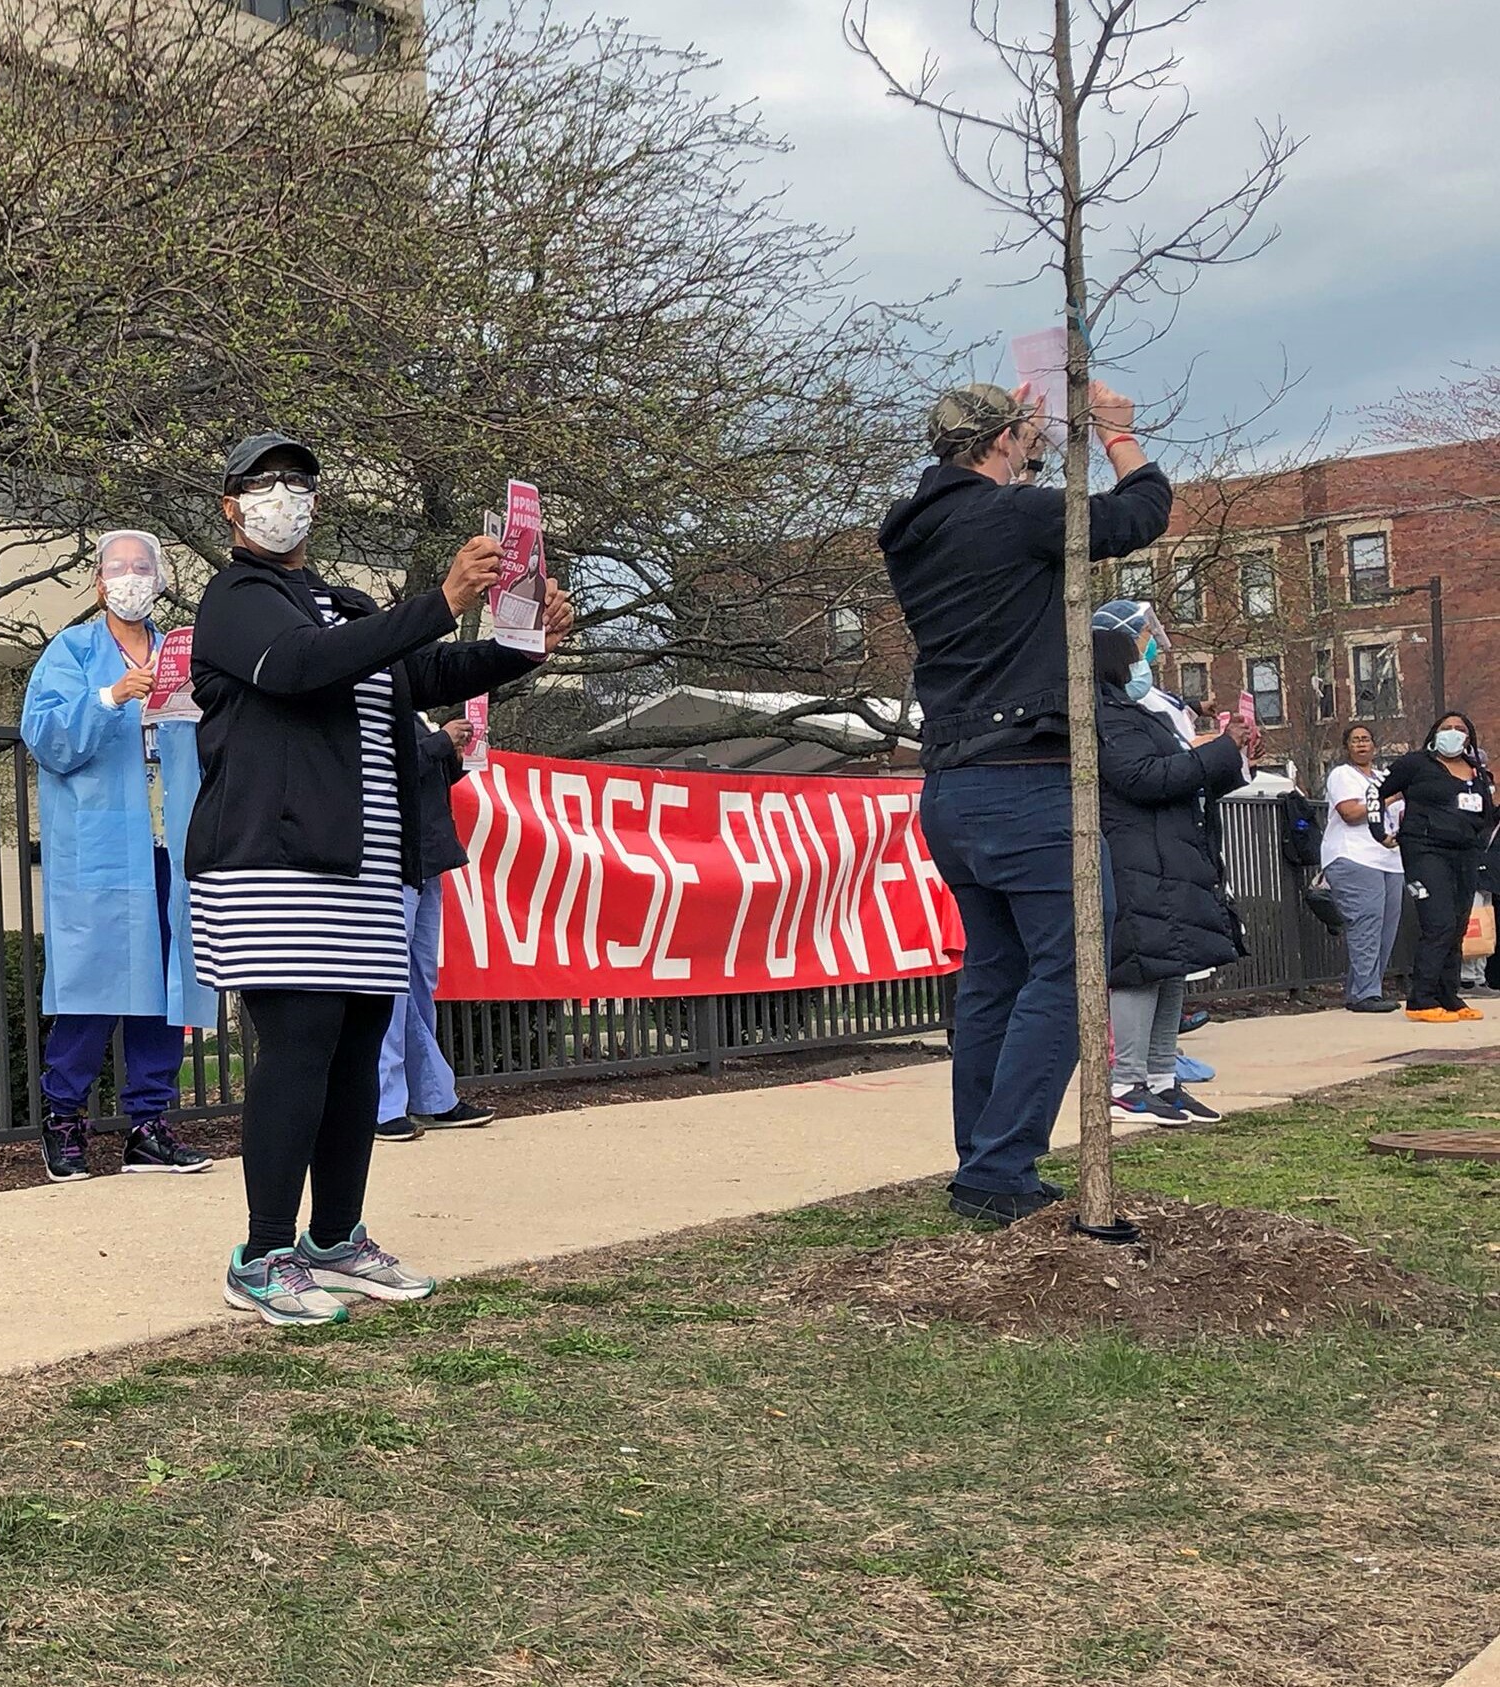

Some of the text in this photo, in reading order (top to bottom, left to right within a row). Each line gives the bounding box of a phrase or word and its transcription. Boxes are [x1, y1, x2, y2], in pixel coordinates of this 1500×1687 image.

[503, 550, 519, 560] VES
[500, 559, 525, 573] PEND
[165, 634, 193, 645] #PRO
[163, 645, 192, 655] NURS
